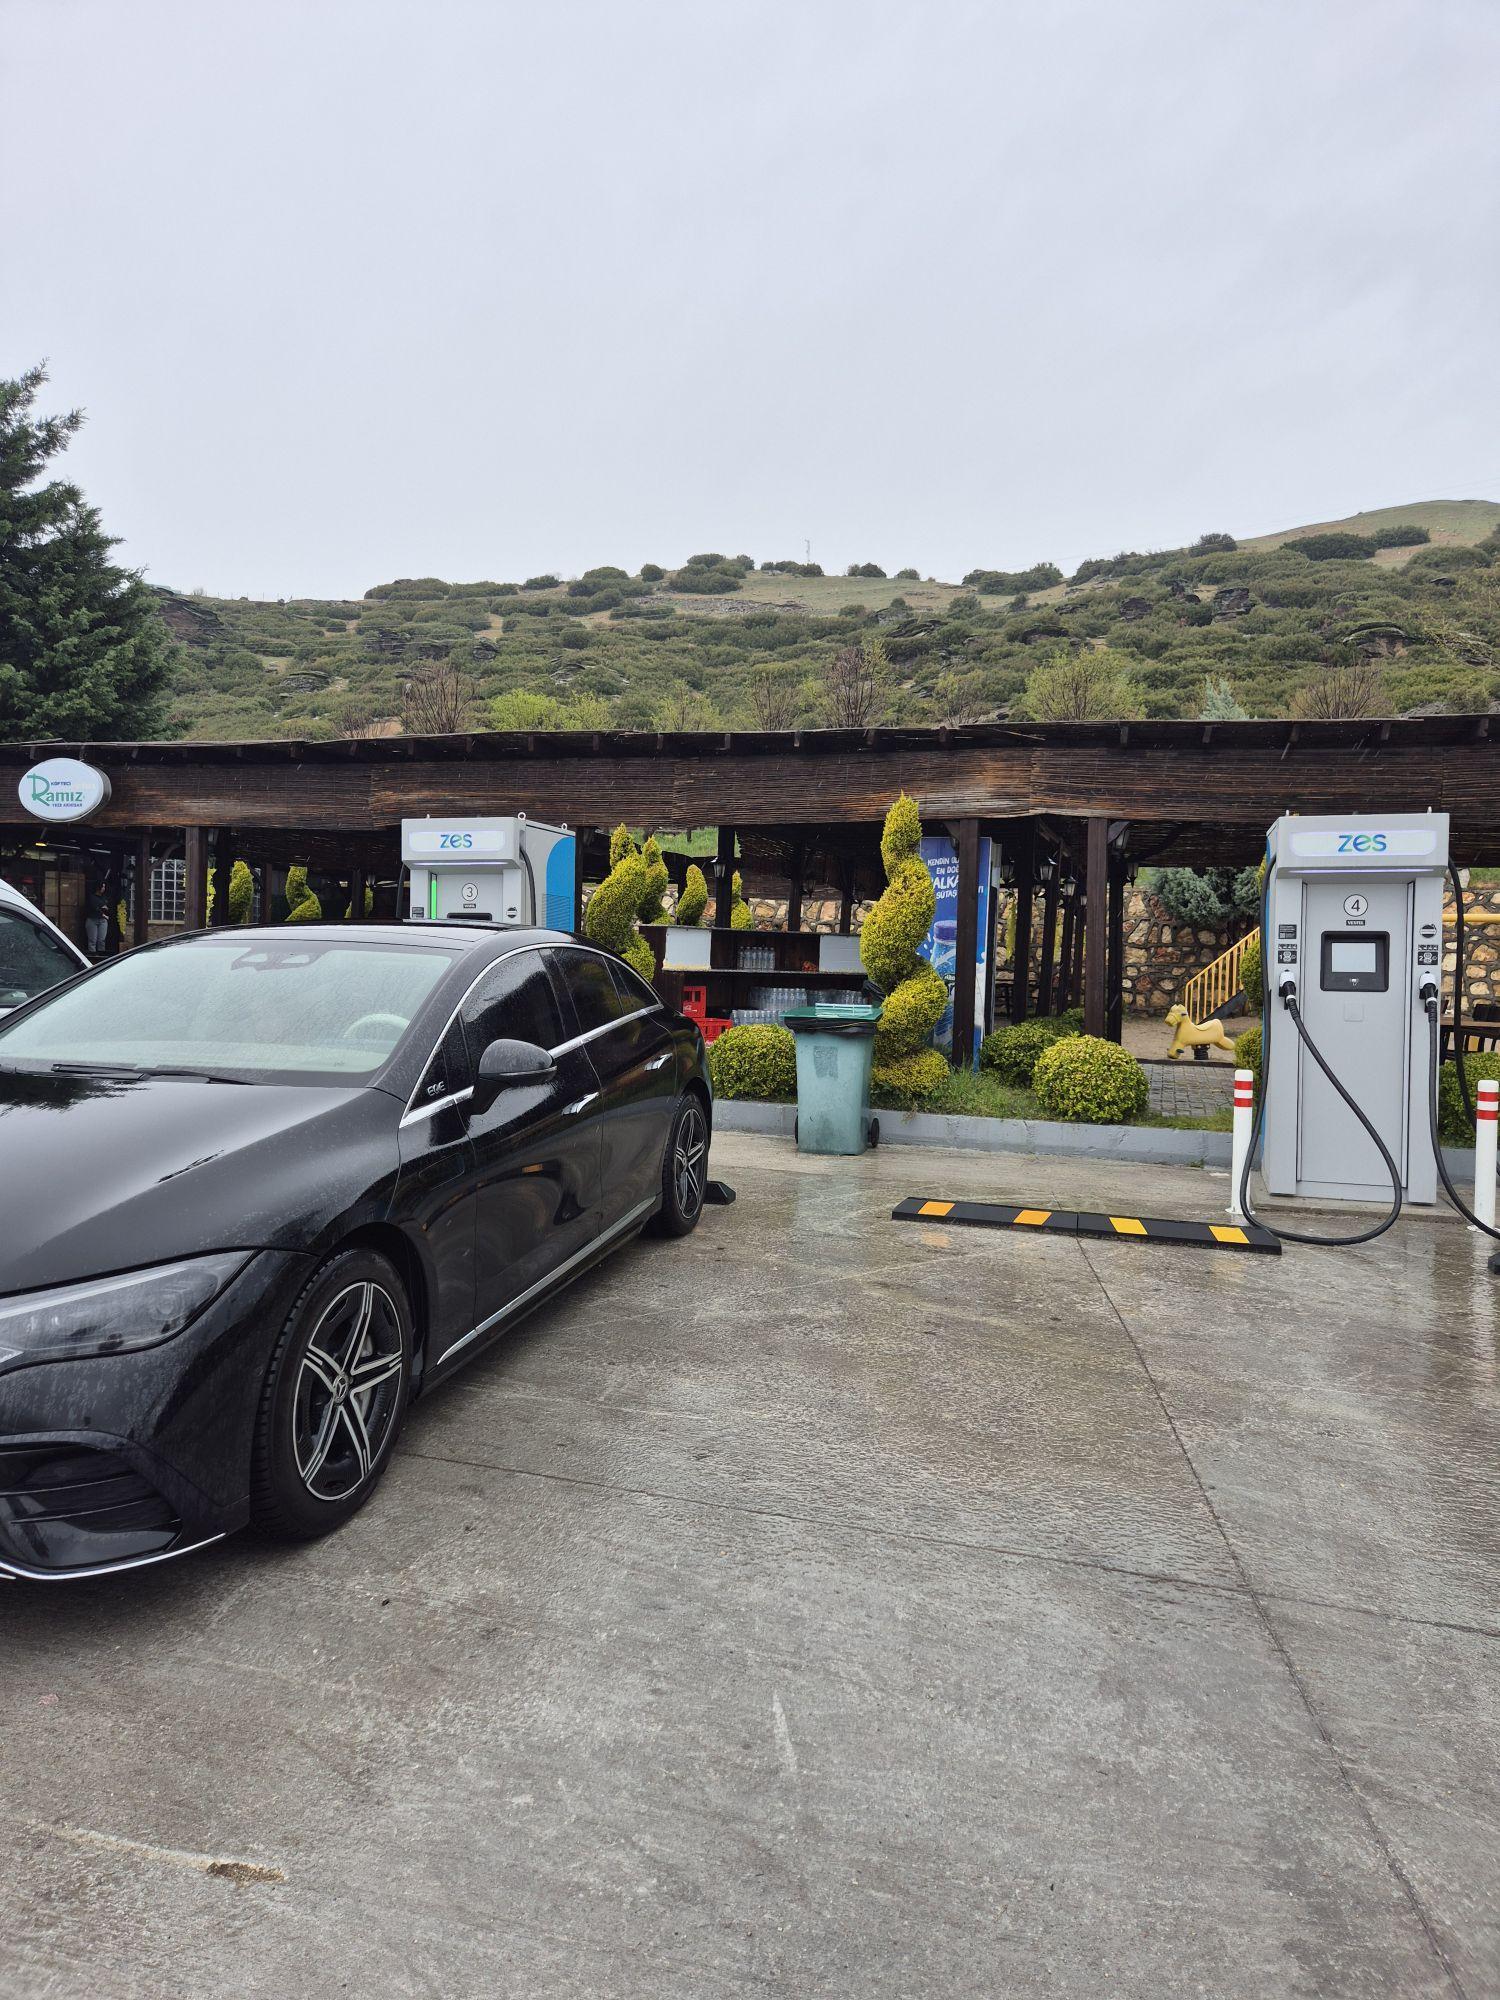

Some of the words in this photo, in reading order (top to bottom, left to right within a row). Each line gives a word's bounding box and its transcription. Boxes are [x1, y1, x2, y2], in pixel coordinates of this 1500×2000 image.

[936, 867, 946, 875] EN
[466, 886, 473, 898] 3
[1351, 900, 1361, 912] 4
